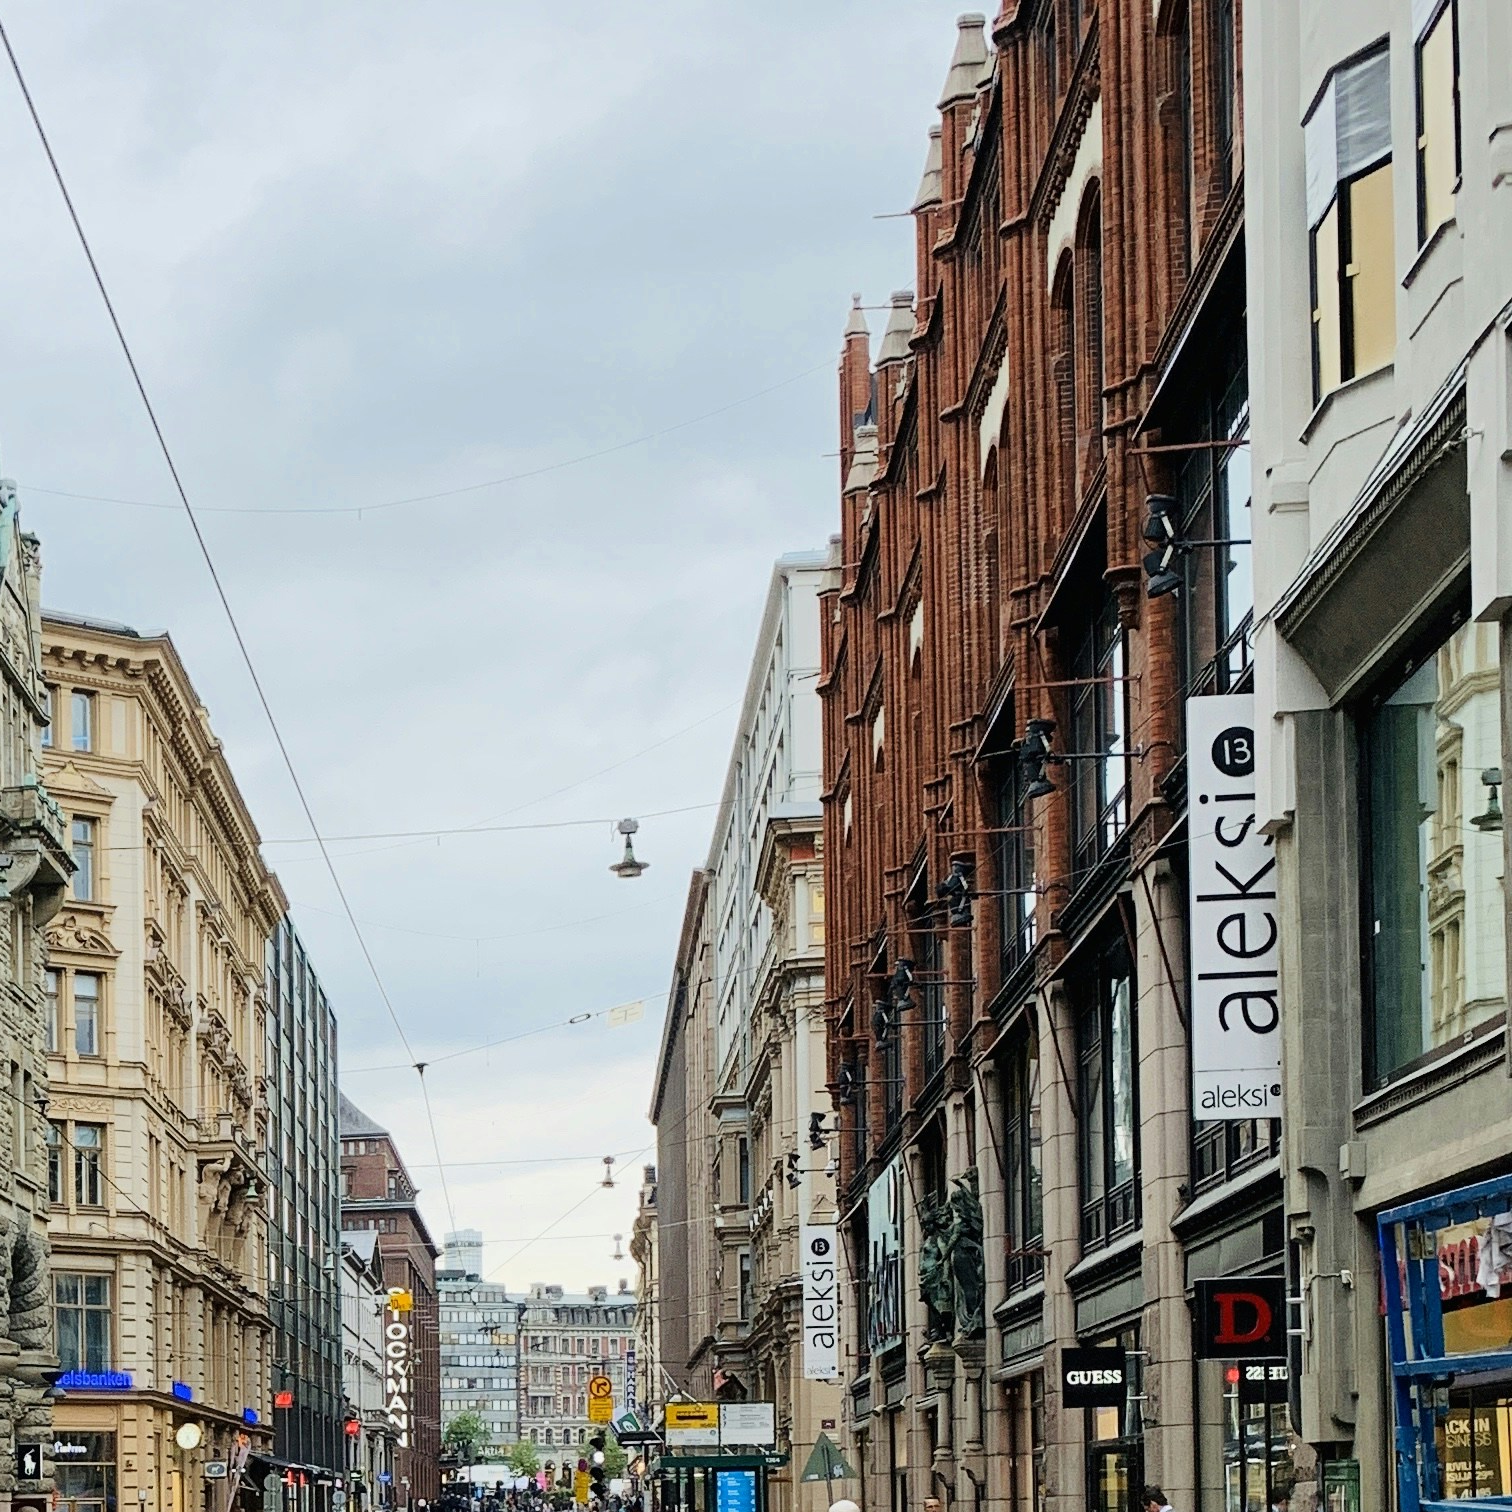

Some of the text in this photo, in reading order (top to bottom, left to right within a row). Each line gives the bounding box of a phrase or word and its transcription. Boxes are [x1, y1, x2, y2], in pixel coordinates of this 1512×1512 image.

[1200, 1083, 1268, 1109] aleksi
[805, 1261, 835, 1349] aleksi
[1066, 1369, 1123, 1386] GUESS
